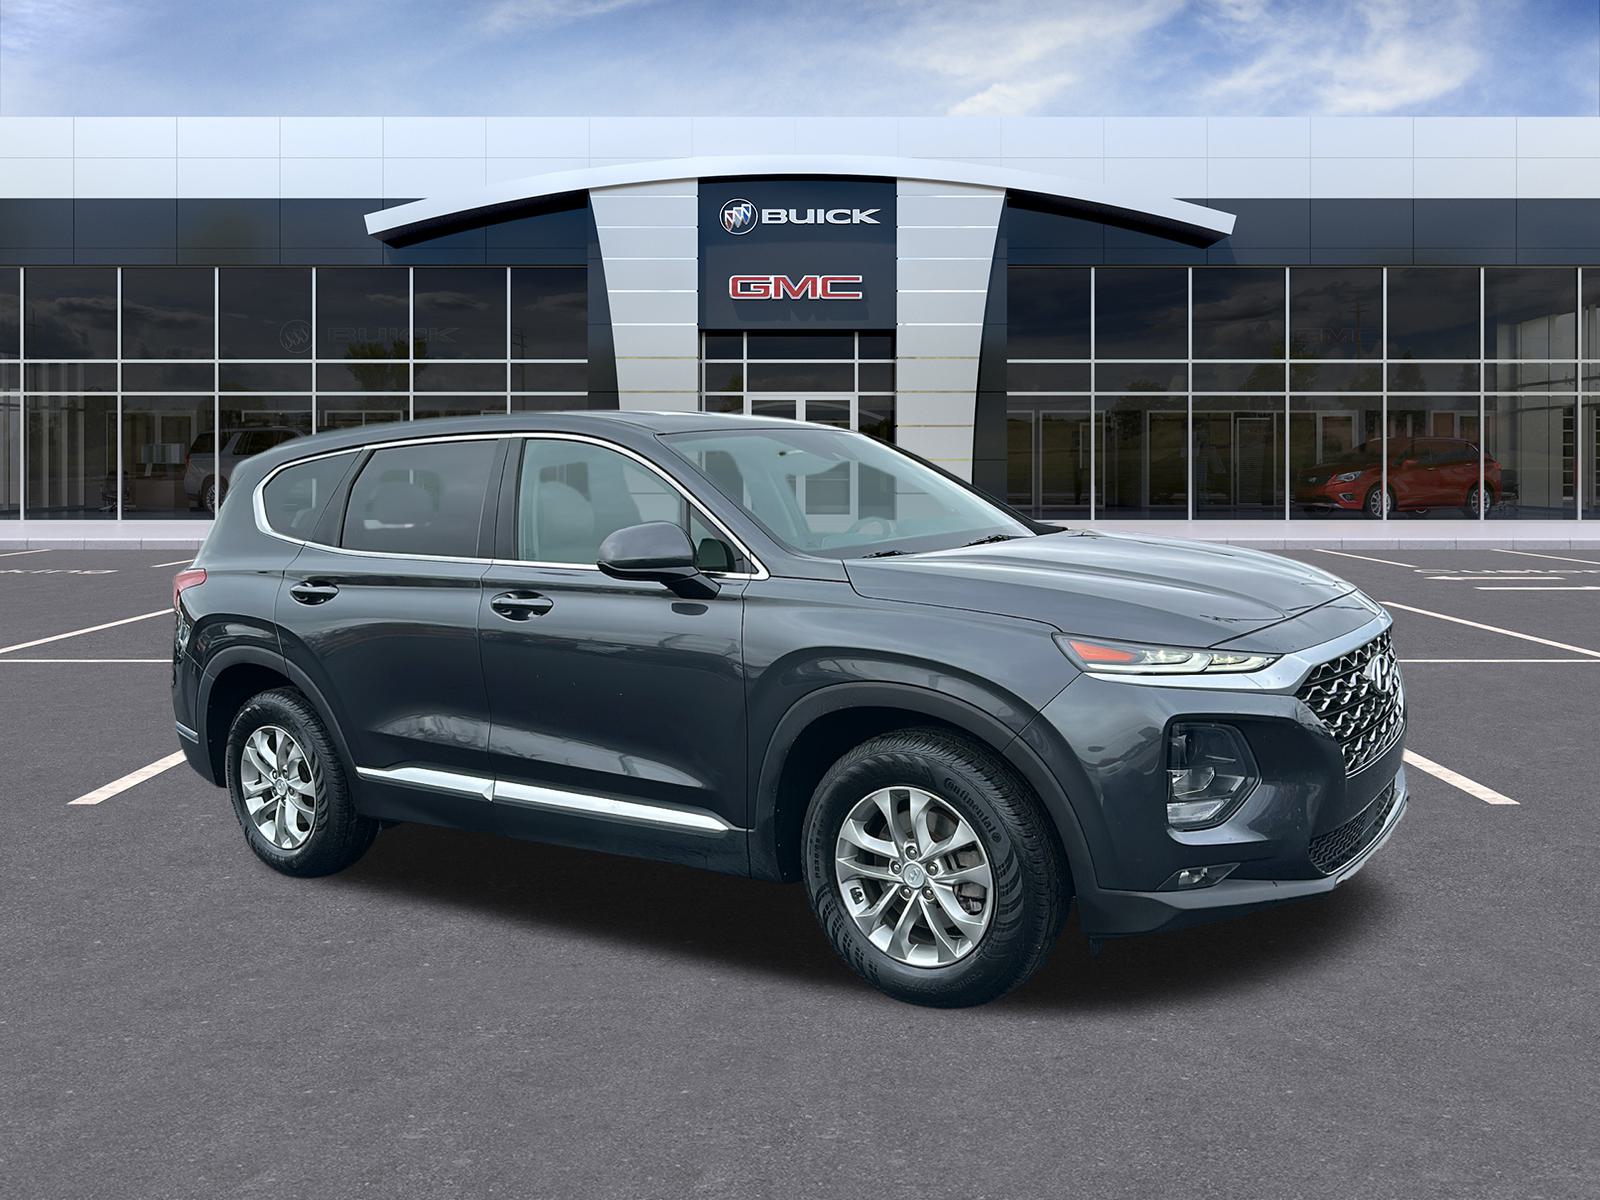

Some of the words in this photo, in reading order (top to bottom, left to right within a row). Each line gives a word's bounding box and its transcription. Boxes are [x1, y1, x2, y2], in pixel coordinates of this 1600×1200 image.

[761, 208, 881, 224] BUICK
[729, 274, 863, 300] GMC
[327, 327, 460, 343] BUICK
[943, 777, 997, 833] Continental
